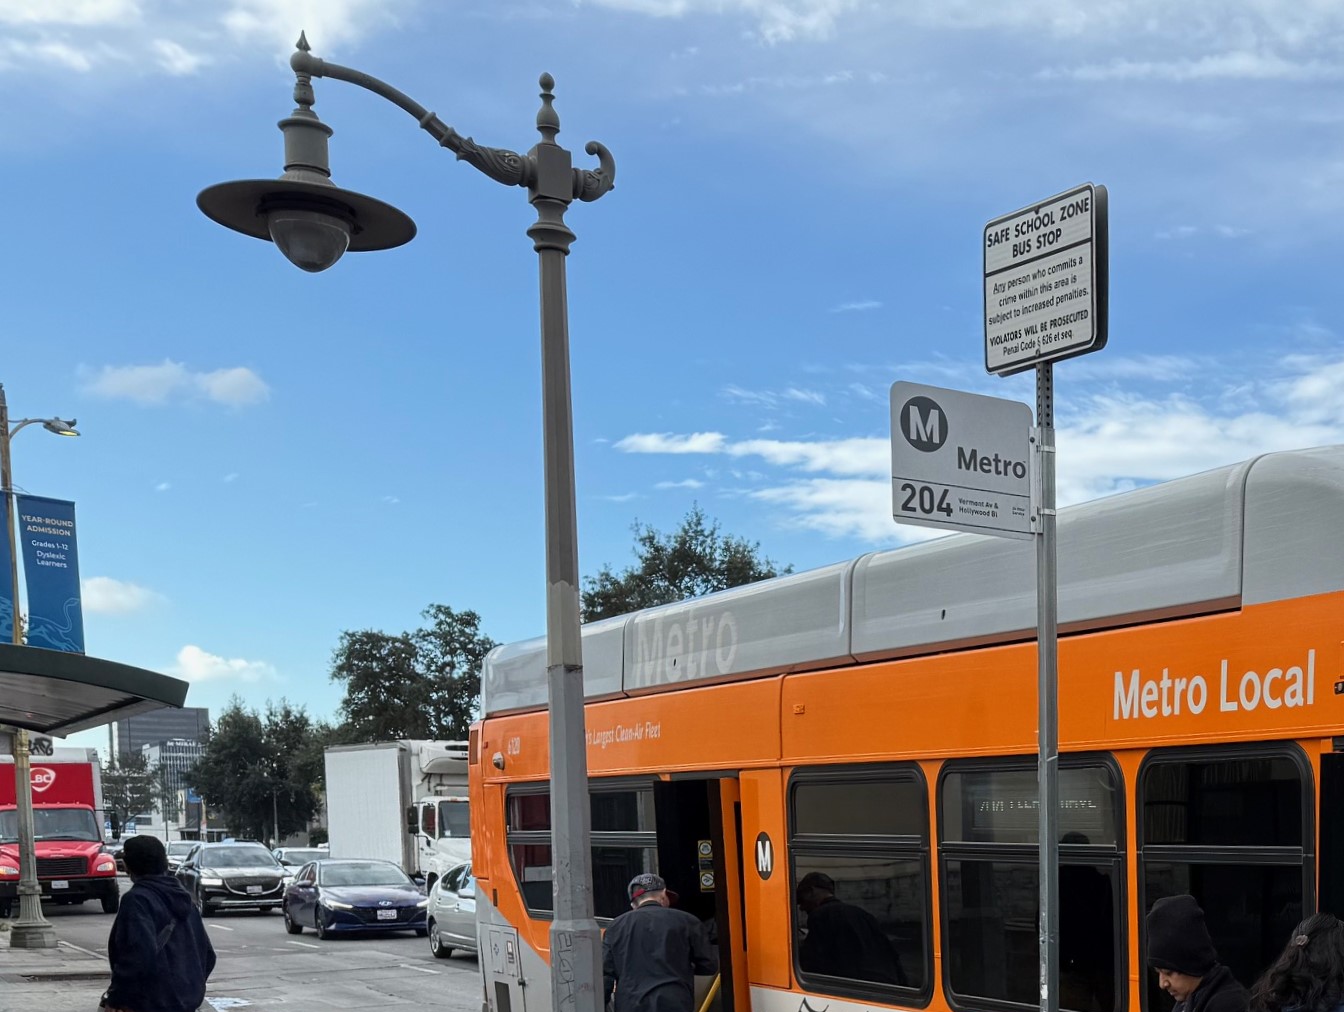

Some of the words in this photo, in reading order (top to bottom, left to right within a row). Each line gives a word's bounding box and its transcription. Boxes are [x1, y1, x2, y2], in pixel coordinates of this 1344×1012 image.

[987, 227, 1010, 248] SAFE
[1014, 211, 1055, 238] SCHOOL
[1060, 197, 1090, 221] ZONE
[1012, 239, 1032, 258] BUS
[1036, 228, 1062, 250] STOP
[993, 282, 1006, 295] Any
[1007, 274, 1031, 290] person
[1032, 267, 1046, 280] who
[1047, 257, 1077, 276] commits
[1078, 256, 1083, 265] a
[998, 294, 1017, 308] crime
[1018, 287, 1039, 301] within
[1039, 280, 1053, 294] this
[1054, 277, 1069, 289] area
[1070, 273, 1077, 284] is
[988, 313, 1012, 326] subject
[1013, 308, 1020, 319] to
[1021, 296, 1054, 316] increased
[1055, 287, 1089, 307] penalties.
[990, 329, 1022, 347] VIOLATORS
[1023, 324, 1038, 337] WILL
[1040, 321, 1048, 332] BE
[1049, 309, 1089, 330] PROSECUTED
[1002, 343, 1019, 356] Penal
[1020, 338, 1036, 352] Code
[1053, 331, 1060, 341] et
[957, 446, 1027, 479] Metro
[900, 482, 954, 518] 204
[959, 506, 990, 516] Hollywood
[21, 514, 73, 528] YEAR-ROUND
[27, 525, 71, 537] ADMISSION
[31, 540, 55, 549] Grades
[36, 550, 66, 560] Dyslexic
[36, 558, 68, 569] Learners
[632, 609, 738, 687] Metro
[1113, 668, 1208, 720] Metro
[1220, 649, 1316, 713] Local
[593, 729, 614, 749] Largest
[615, 723, 643, 742] Clean-Air
[645, 721, 661, 740] Fleet
